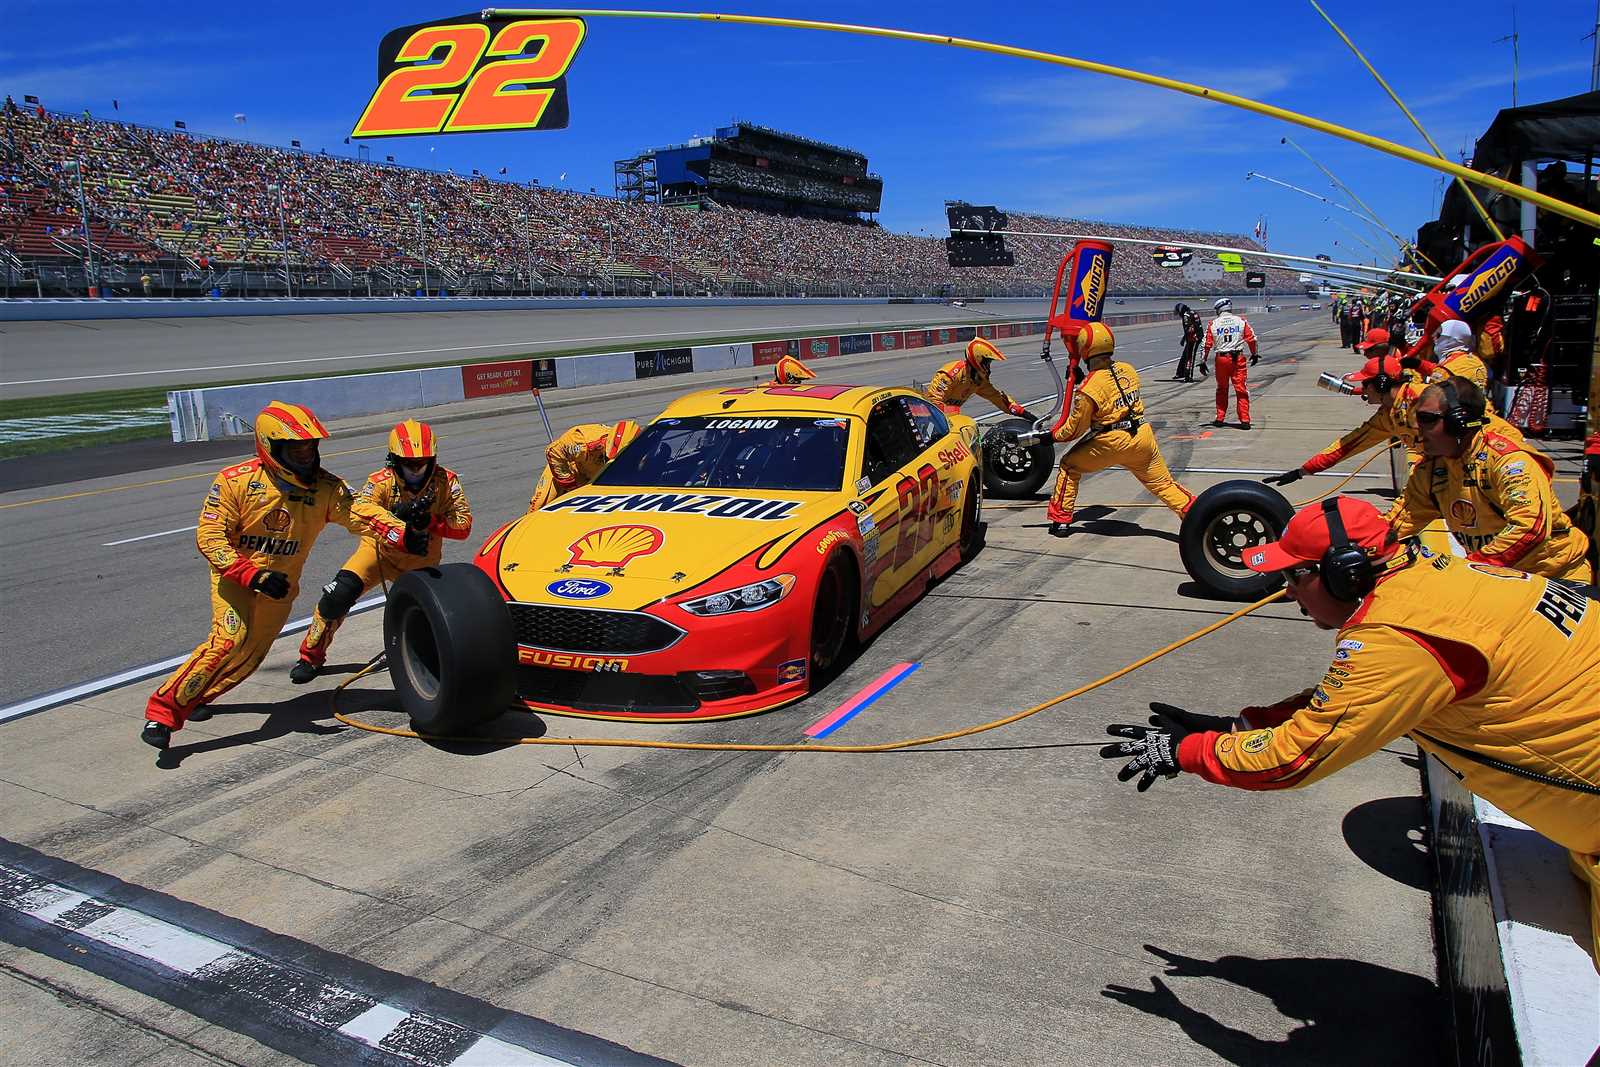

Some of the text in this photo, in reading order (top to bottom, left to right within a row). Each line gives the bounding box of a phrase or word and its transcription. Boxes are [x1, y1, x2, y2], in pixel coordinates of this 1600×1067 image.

[351, 18, 587, 137] 22
[1085, 255, 1105, 316] SUNOCO
[1461, 256, 1518, 310] SUNOCO
[1216, 325, 1240, 337] Mobil
[636, 351, 691, 371] PURE MICHIGAN
[705, 419, 779, 430] LOGANO
[937, 441, 970, 470] Shell
[541, 494, 803, 521] PENNZOIL
[557, 580, 600, 596] Ford
[518, 650, 629, 673] FUSION
